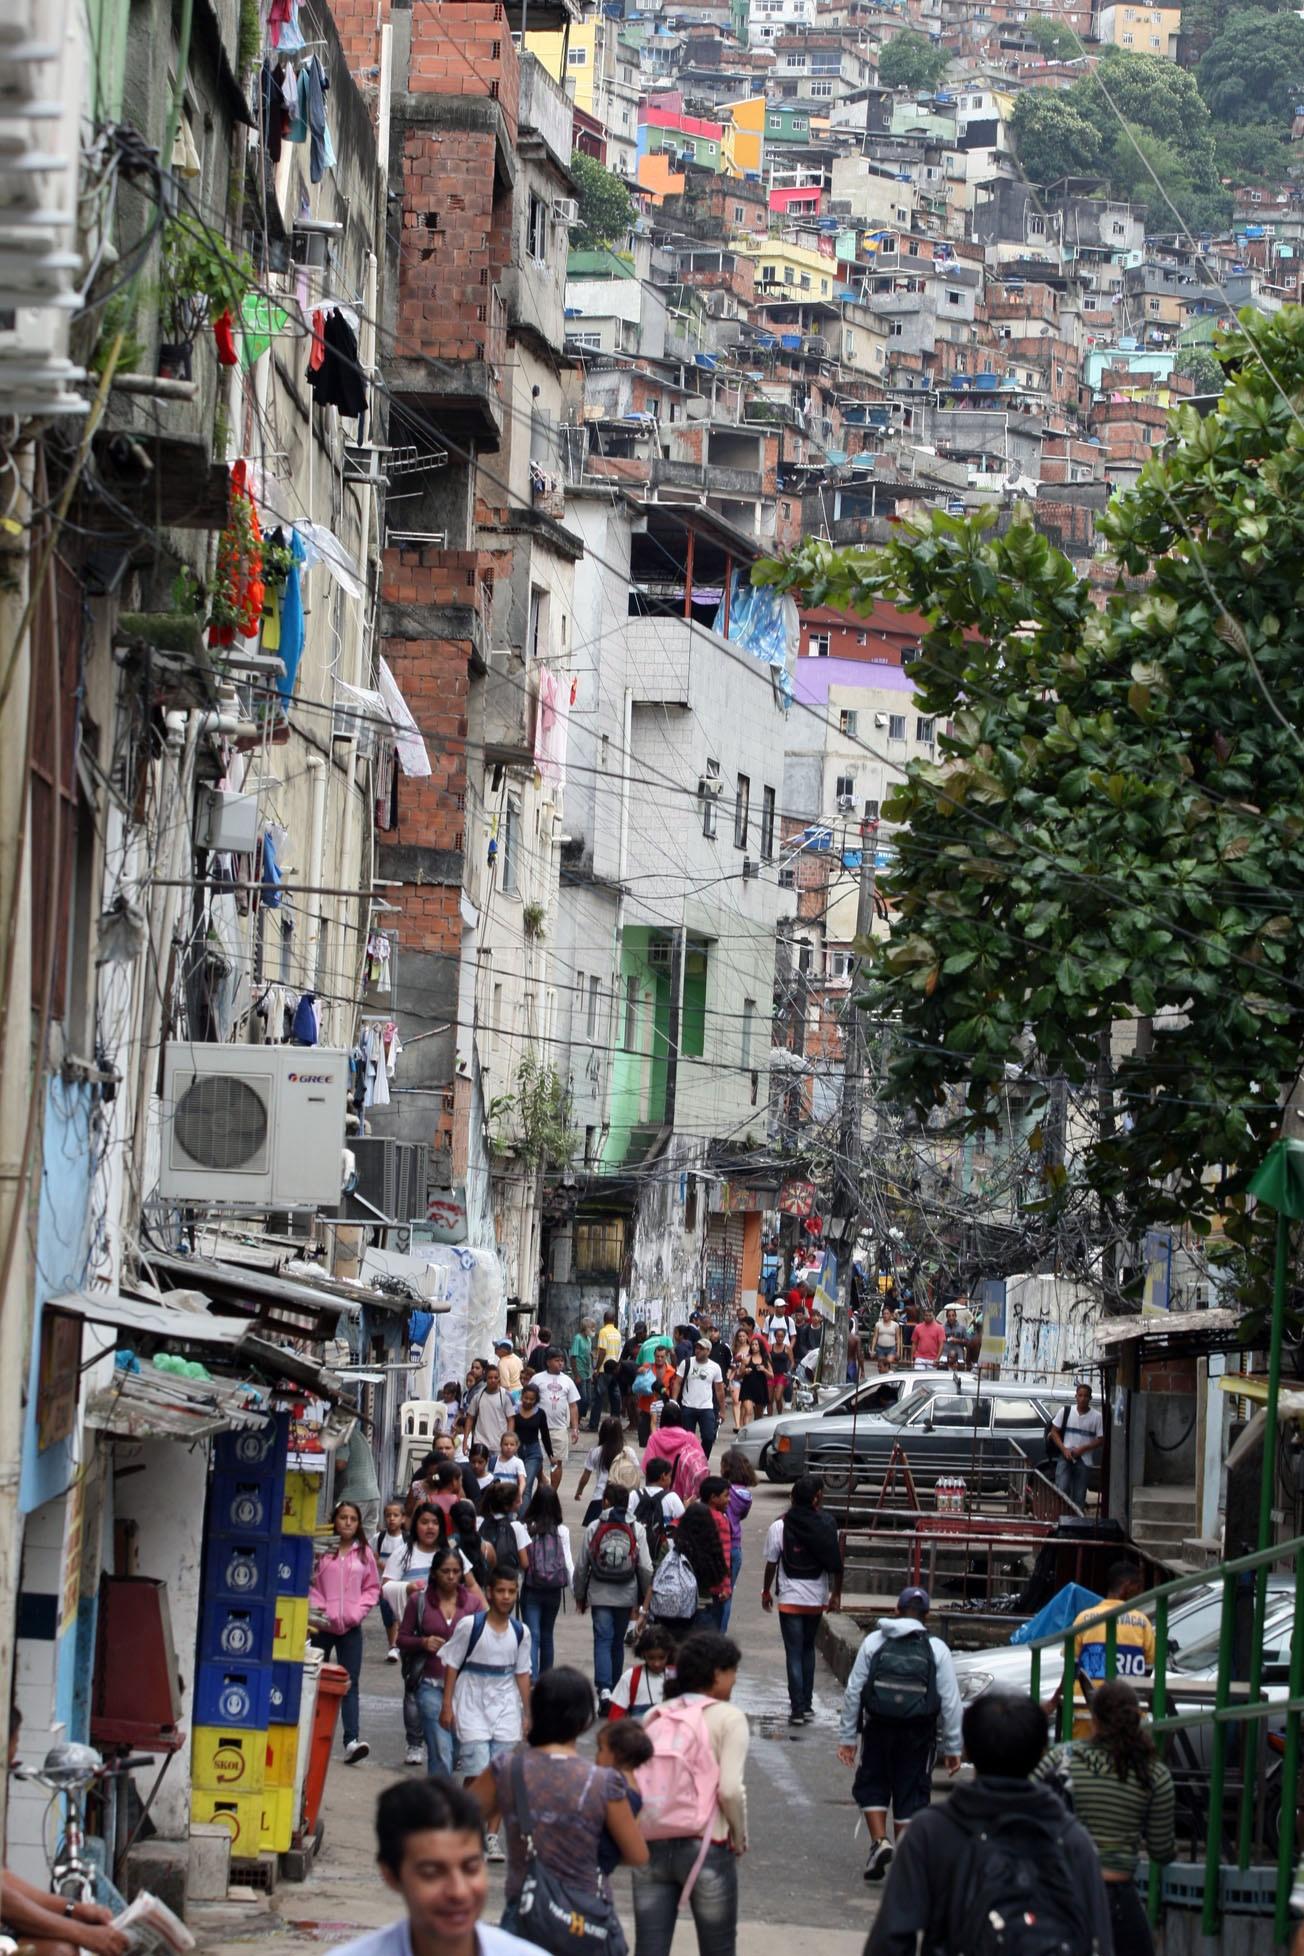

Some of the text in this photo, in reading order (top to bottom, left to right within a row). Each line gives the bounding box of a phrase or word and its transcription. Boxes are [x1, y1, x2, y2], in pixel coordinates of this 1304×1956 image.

[299, 1075, 335, 1084] GREE
[1115, 1653, 1146, 1676] RIO
[213, 1760, 241, 1771] SKOL
